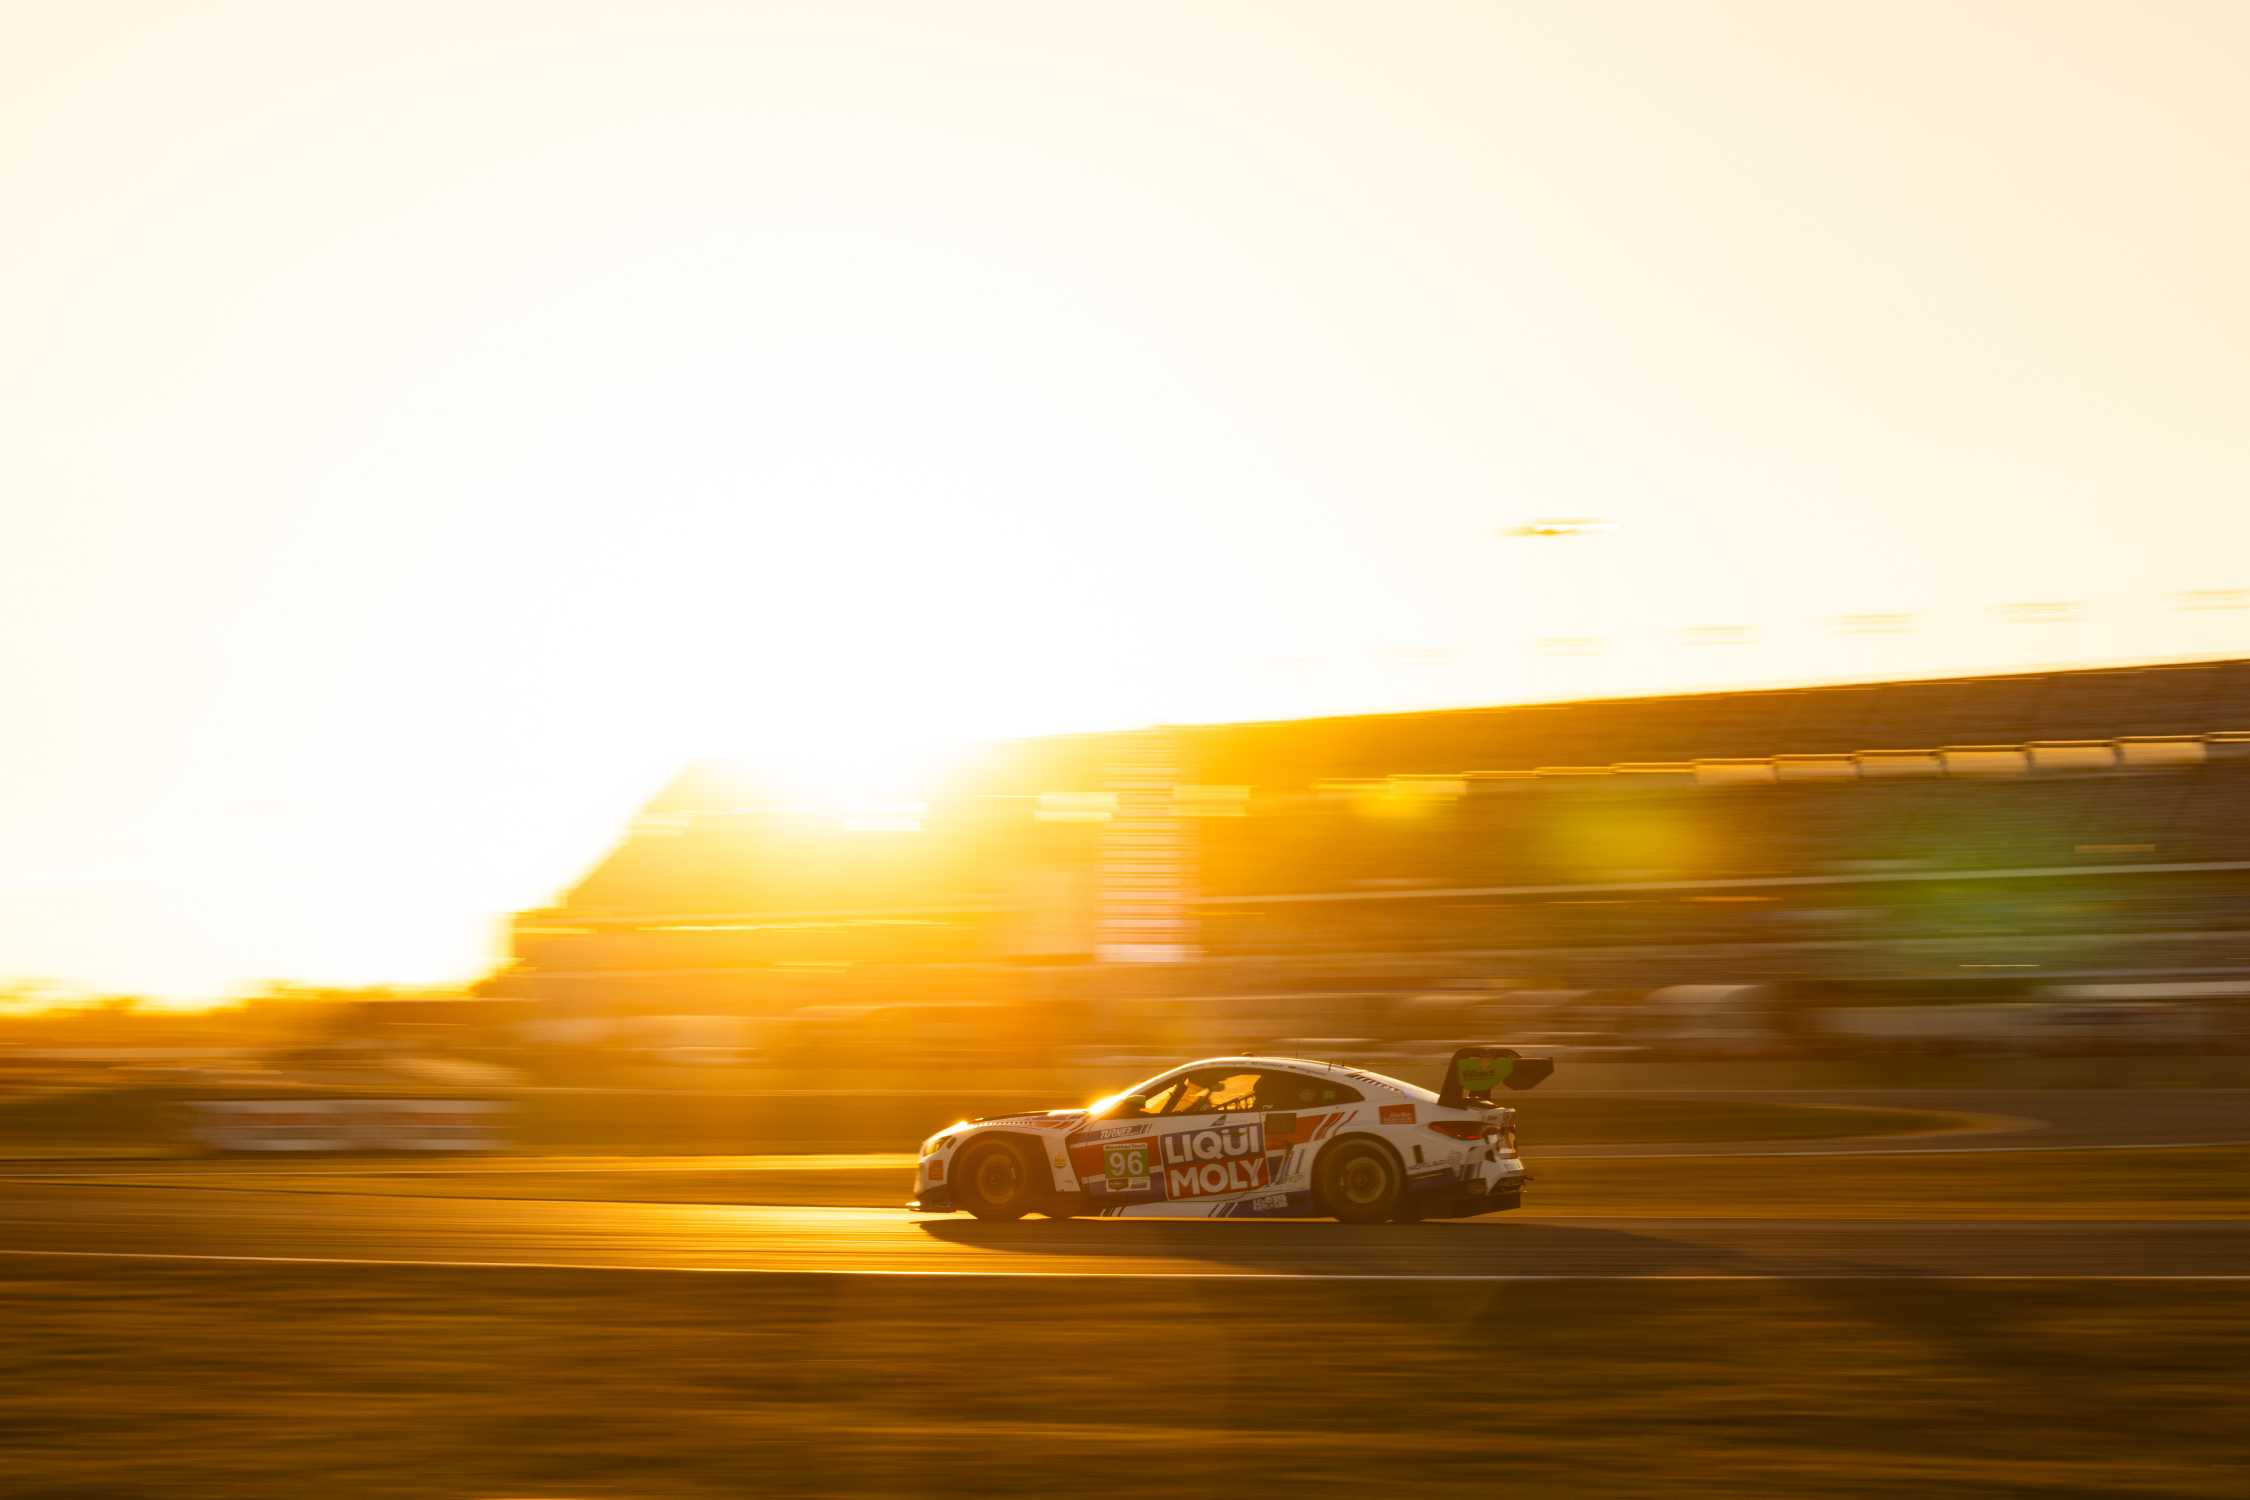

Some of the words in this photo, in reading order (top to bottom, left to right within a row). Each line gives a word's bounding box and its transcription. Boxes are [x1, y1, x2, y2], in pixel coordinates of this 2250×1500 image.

[1109, 1151, 1143, 1176] 96
[1165, 1125, 1260, 1165] LIQUI
[1170, 1158, 1264, 1197] MOLY
